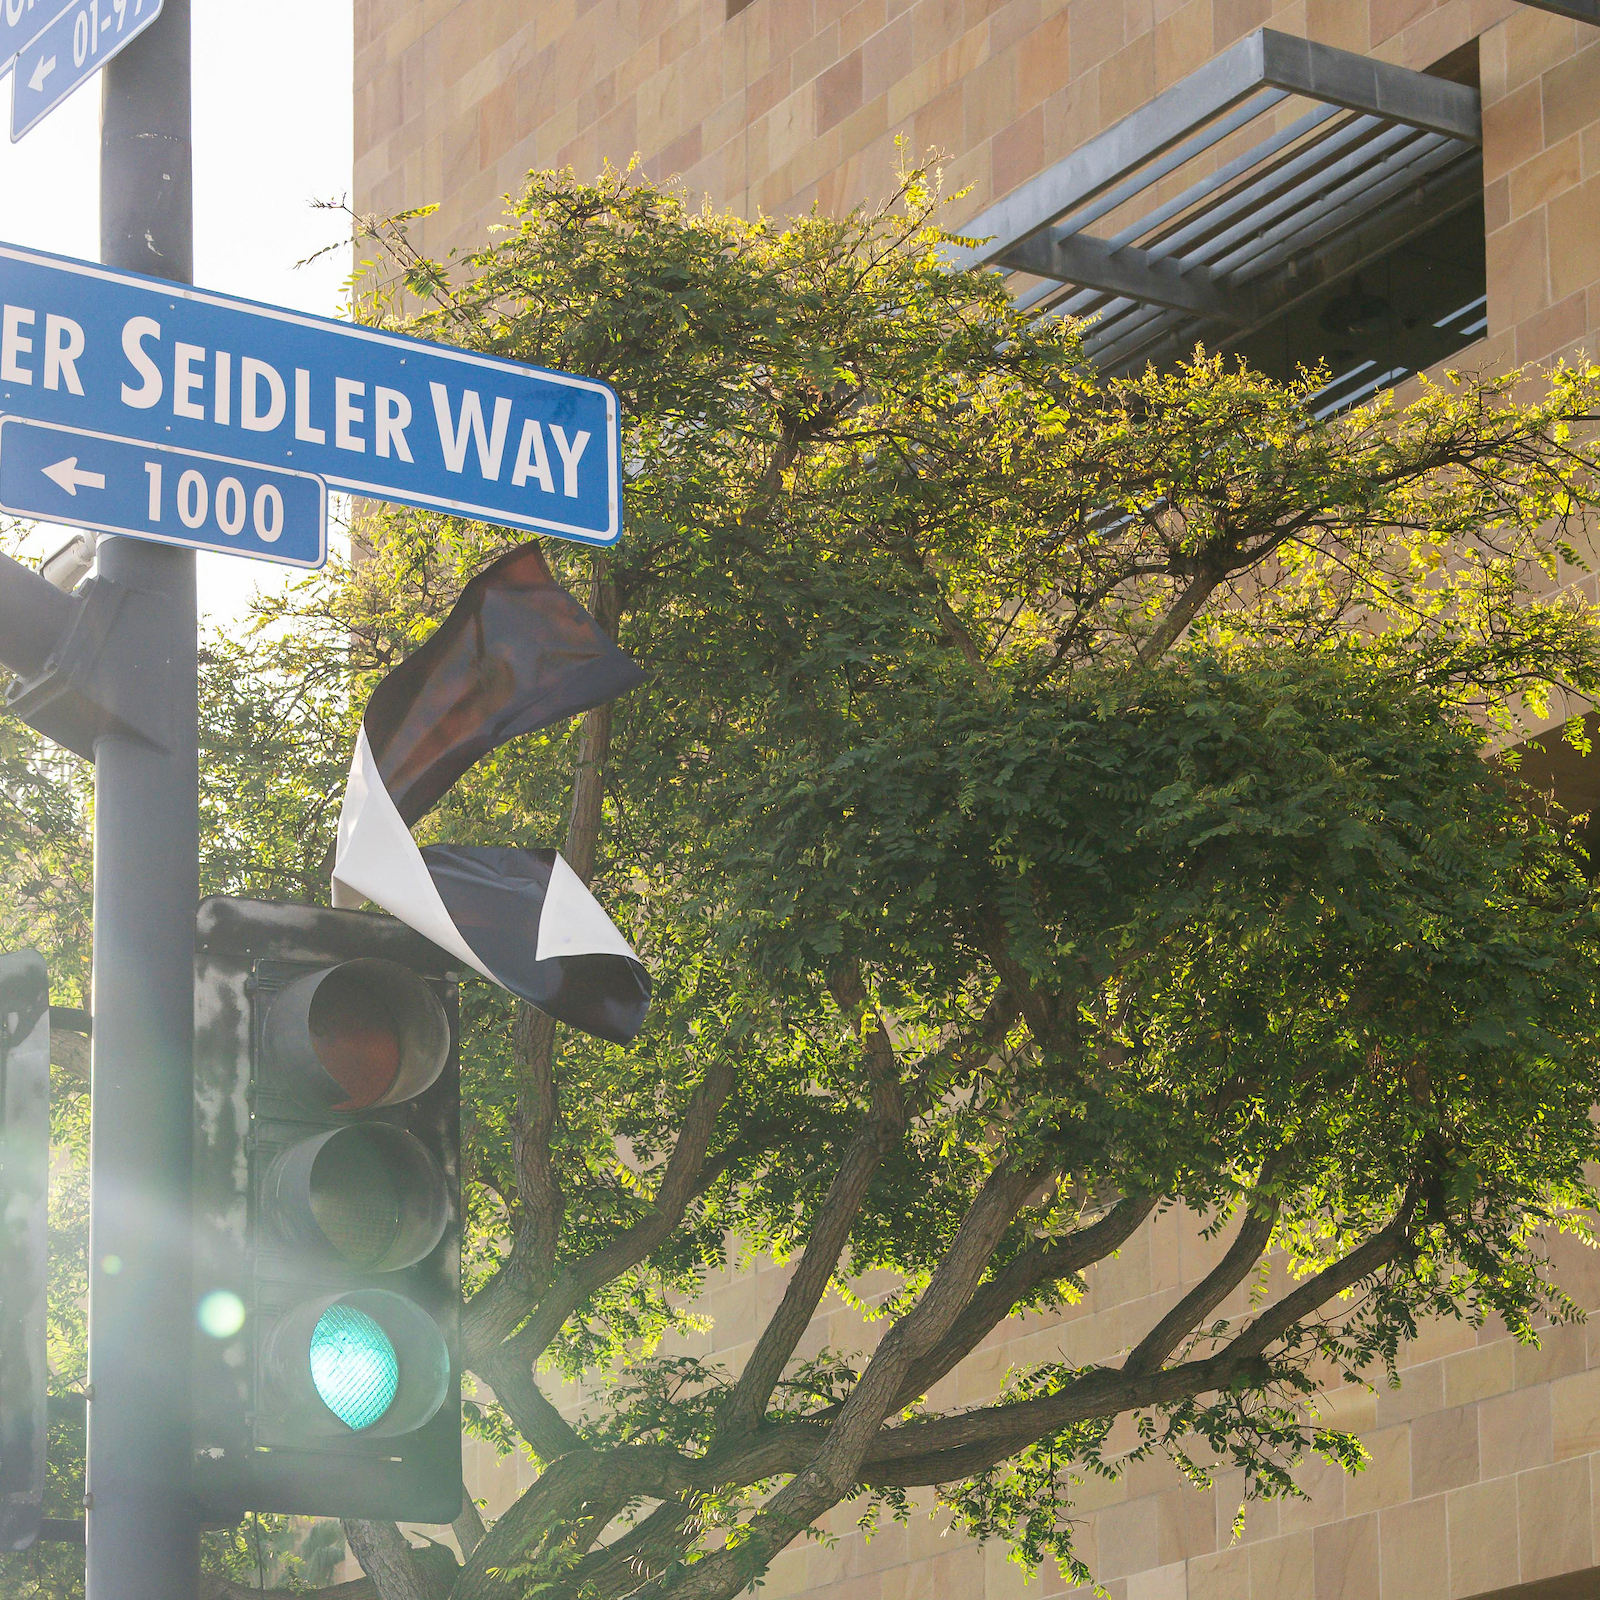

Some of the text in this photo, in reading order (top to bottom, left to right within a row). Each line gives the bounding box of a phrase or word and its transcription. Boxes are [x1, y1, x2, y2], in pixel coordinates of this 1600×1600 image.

[120, 316, 414, 465] SEIDLER
[428, 380, 592, 499] WAY
[143, 460, 285, 543] 1000
